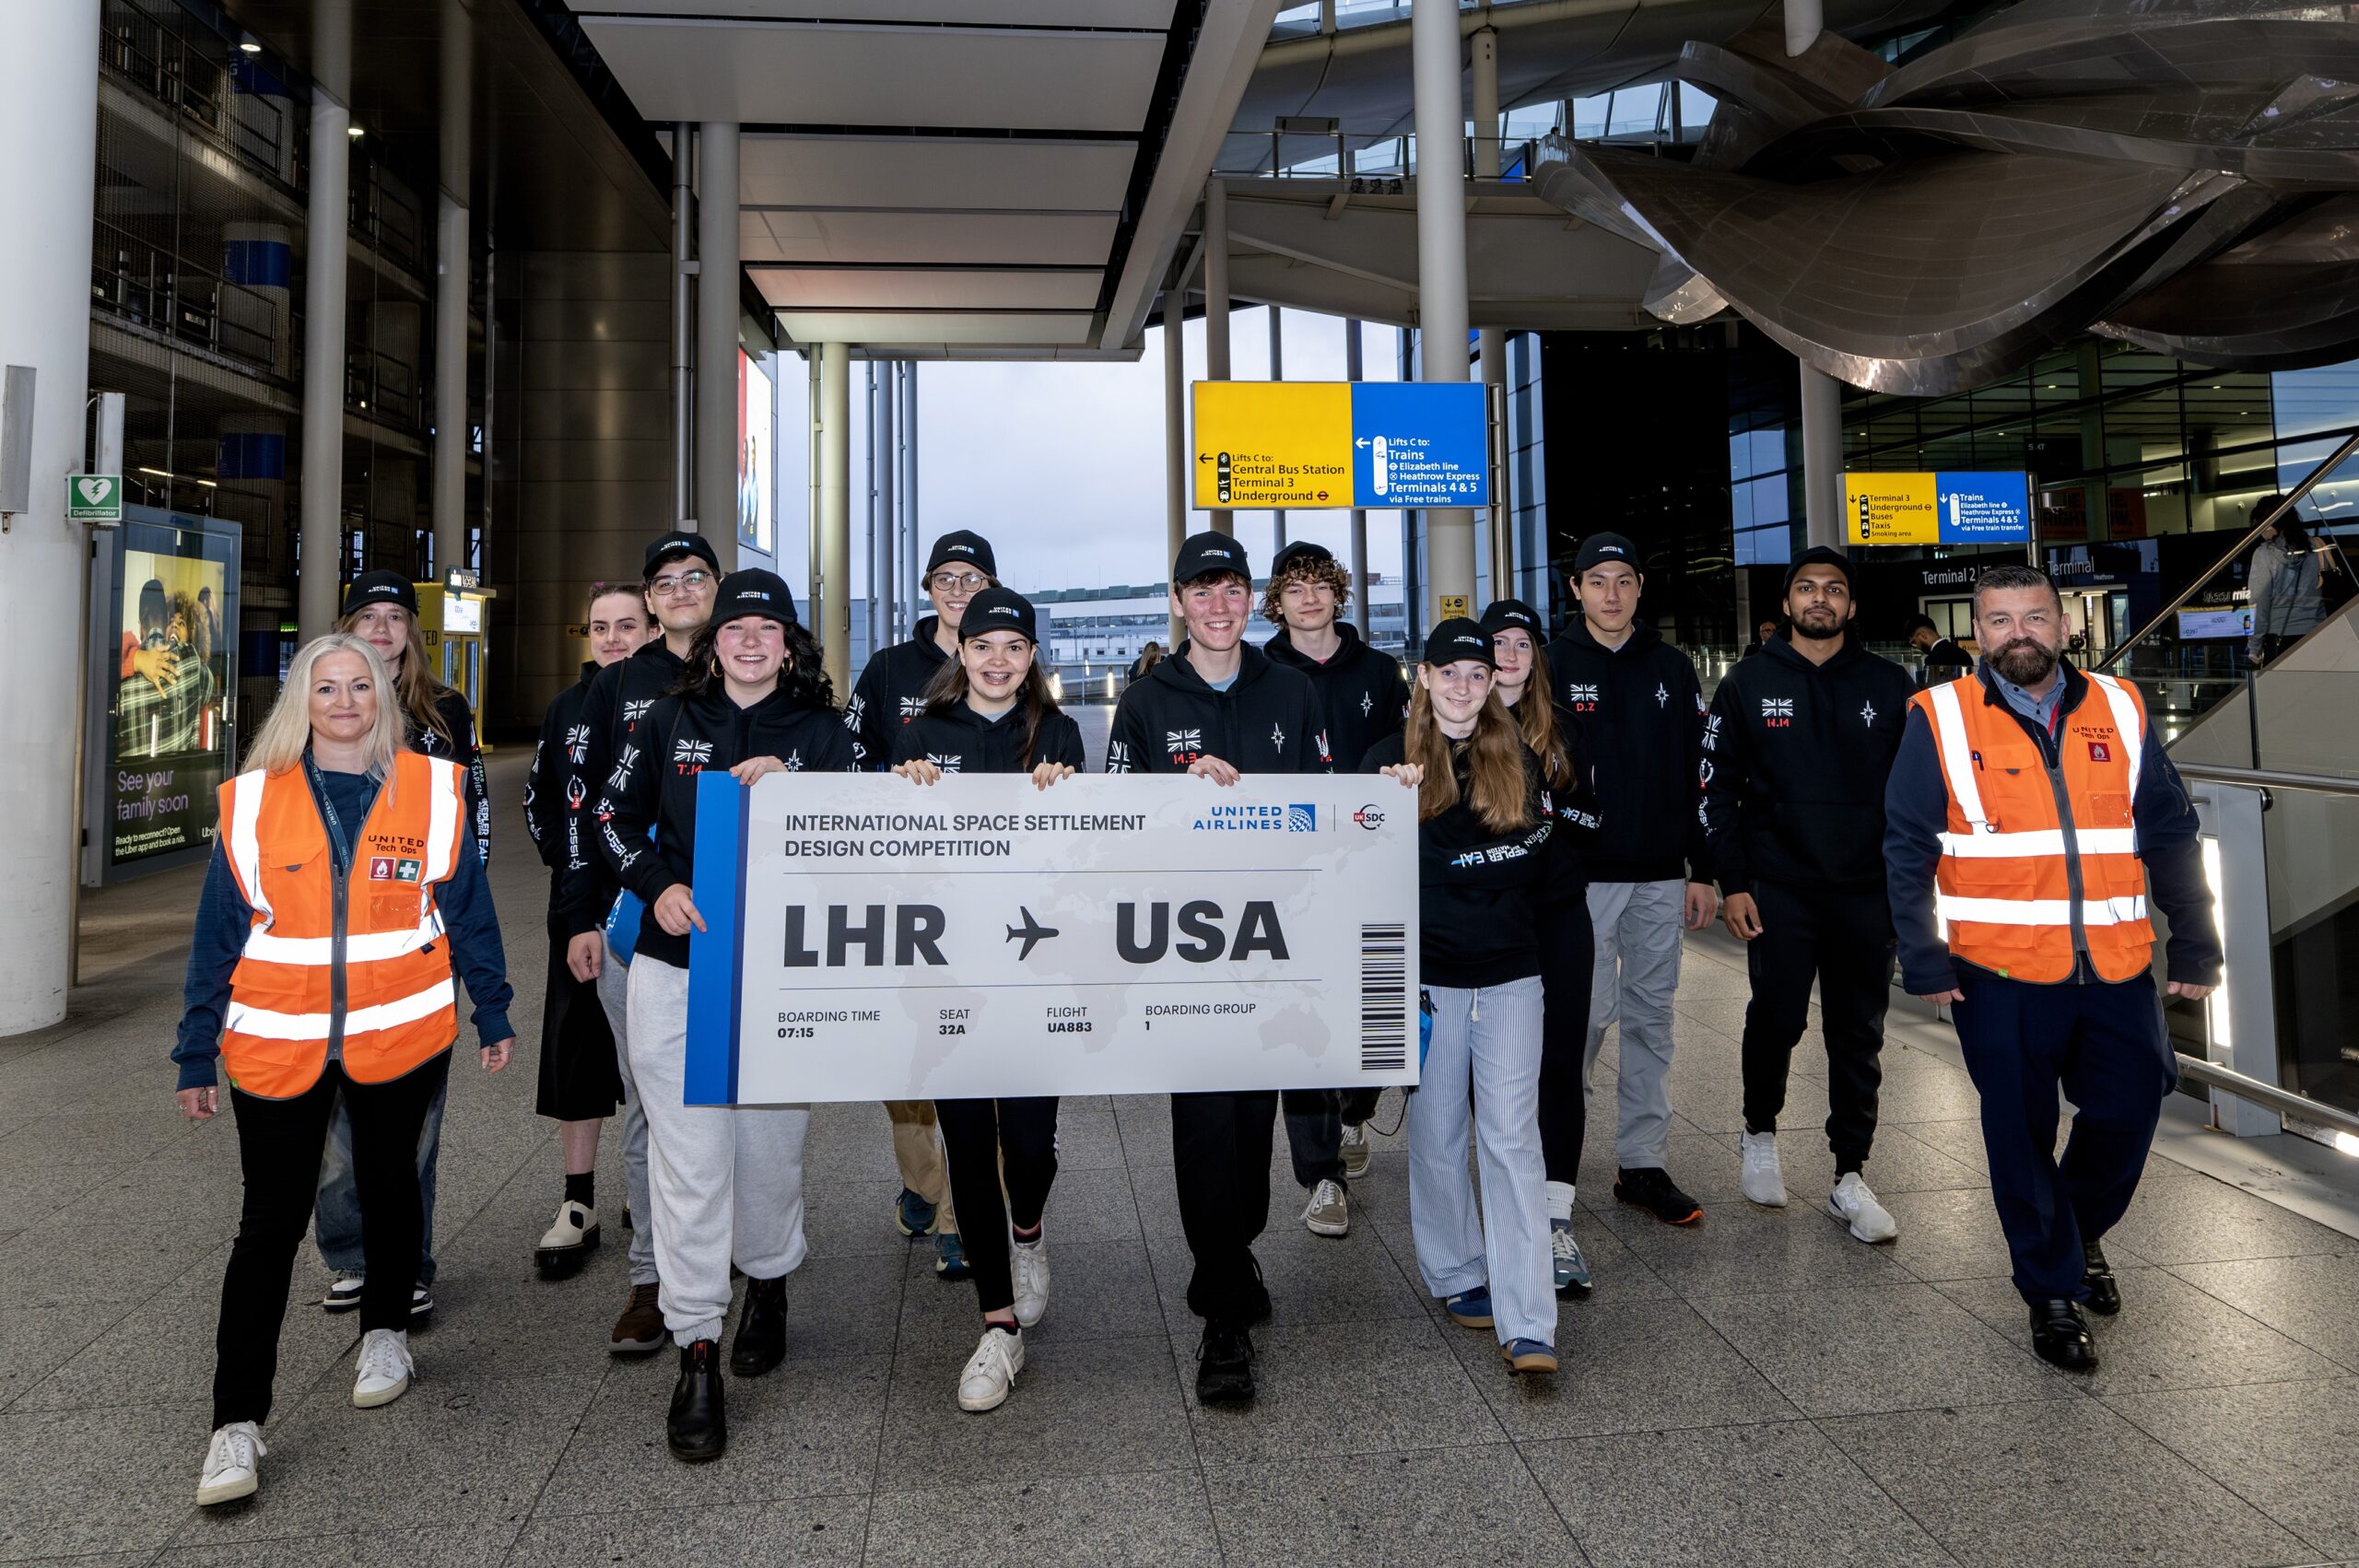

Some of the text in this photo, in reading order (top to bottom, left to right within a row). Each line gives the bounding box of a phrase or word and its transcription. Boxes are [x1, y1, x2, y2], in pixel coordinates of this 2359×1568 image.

[1389, 438, 1430, 447] Lifts C to:
[1232, 452, 1273, 462] Lifts C to:
[1389, 450, 1425, 460] Trains
[1232, 463, 1344, 474] Central Bus Station
[1400, 462, 1459, 471] Elizabeth line
[1233, 477, 1294, 488] Terminal 3
[1400, 472, 1480, 483] Heathrow Express
[1389, 482, 1477, 493] Terminals 4 & 5
[1233, 490, 1313, 502] Underground
[1389, 495, 1451, 503] via Free trains
[1870, 503, 1923, 512] Underground
[2048, 556, 2095, 576] Terminal
[1922, 568, 1966, 585] Terminal
[1969, 567, 1976, 581] 2
[1576, 703, 1595, 711] D.Z
[2072, 725, 2115, 733] UNITED
[118, 769, 174, 794] See your
[471, 766, 484, 795] SAPIEN
[117, 794, 189, 822] family soon
[323, 800, 337, 826] UNITED
[1212, 806, 1283, 816] UNITED
[480, 800, 489, 837] KEPLER
[785, 814, 1146, 832] INTERNATIONAL SPACE SETTLEMENT
[1193, 820, 1283, 830] AIRLINES
[115, 826, 181, 846] Ready to reconnect? Open
[368, 835, 425, 848] UNITED
[115, 847, 125, 857] the
[124, 843, 138, 855] Uber
[137, 844, 149, 854] app
[148, 841, 158, 849] and
[159, 838, 171, 848] book
[175, 835, 186, 844] ride.
[375, 843, 417, 855] Tech Ops
[784, 840, 1011, 857] DESIGN COMPETITION
[783, 900, 1291, 967] LHR USA
[938, 1008, 971, 1021] SEAT
[1047, 1006, 1088, 1019] FLIGHT
[1145, 1002, 1257, 1016] BOARDING GROUP
[778, 1010, 881, 1024] BOARDING TIME
[938, 1024, 967, 1036] 32A
[1047, 1022, 1093, 1034] UA883
[1144, 1021, 1151, 1031] 1
[777, 1027, 815, 1038] 07:15
